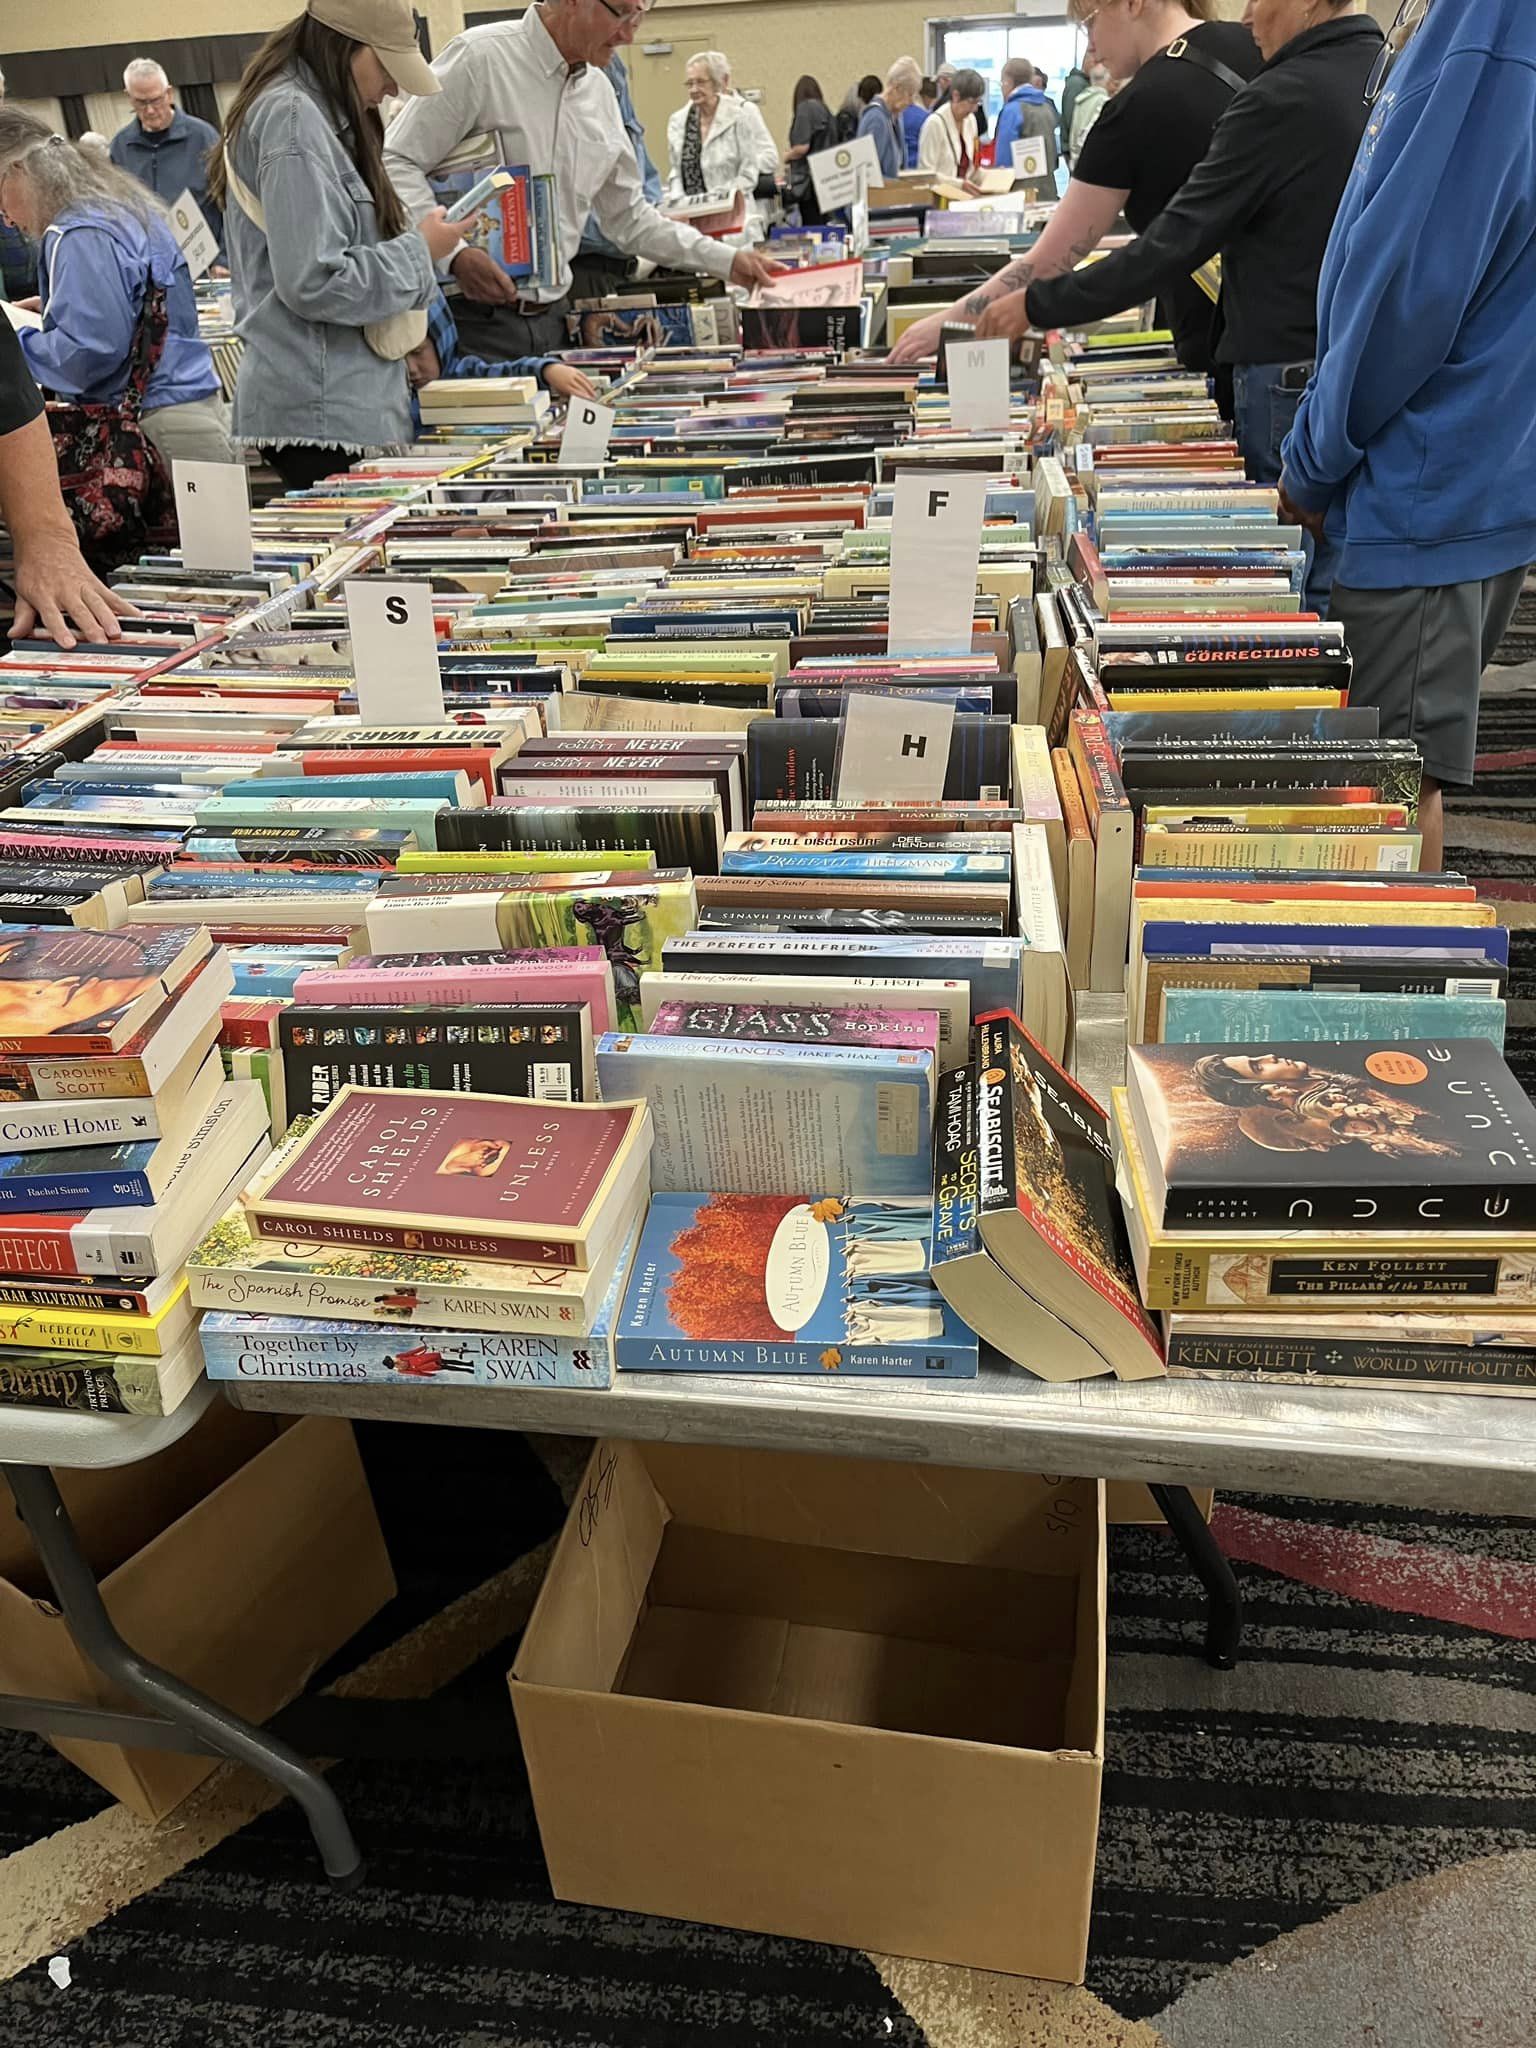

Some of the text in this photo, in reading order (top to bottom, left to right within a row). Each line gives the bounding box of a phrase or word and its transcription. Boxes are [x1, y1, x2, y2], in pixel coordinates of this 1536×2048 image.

[966, 349, 985, 367] M
[582, 408, 596, 425] D
[187, 481, 196, 493] R
[928, 490, 949, 517] F
[385, 595, 409, 625] S
[1184, 647, 1321, 663] CORRECTIONS
[341, 730, 506, 742] DIRTY WARS
[624, 738, 688, 751] NEVER
[901, 734, 928, 759] H
[602, 755, 666, 768] NEVER
[785, 747, 796, 786] window
[770, 837, 882, 847] FULL DISCLOSURE
[892, 841, 972, 849] HENDERSON
[426, 880, 546, 893] THE ILLEGAL
[701, 877, 730, 886] Tales
[750, 879, 766, 888] of
[767, 879, 807, 888] School
[39, 894, 83, 906] JOHN
[720, 912, 770, 920] HAYNES
[671, 940, 880, 952] THE PERFECT GIRLFRIEND
[393, 968, 434, 979] Brain
[497, 963, 575, 973] HAZELWOOD
[883, 979, 924, 988] HOFF
[472, 1002, 517, 1010] ANTHONY
[686, 1005, 926, 1039] GLASS Hopkins
[702, 1043, 786, 1058] CHANCES
[798, 1050, 833, 1059] HAKE
[847, 1053, 882, 1061] HAKE
[981, 1023, 990, 1069] HILLENBRAND
[994, 1031, 1003, 1055] LAURA
[37, 1065, 118, 1081] CAROLINE
[403, 1063, 415, 1077] the
[56, 1081, 106, 1095] SCOTT
[311, 1064, 330, 1106] RIDER
[945, 1084, 963, 1152] TAMI HOAG
[2, 1118, 122, 1141] COME HOME
[985, 1085, 1004, 1182] SEABISCUIT
[347, 1117, 410, 1185] CAROL
[362, 1105, 439, 1199] SHIELDS
[499, 1121, 561, 1203] UNLESS
[950, 1172, 957, 1182] TO
[27, 1185, 91, 1198] Rachel Simon
[958, 1150, 978, 1231] SECRETS
[938, 1173, 958, 1241] THE GRAVE
[1197, 1199, 1250, 1207] FRANK
[262, 1219, 500, 1253] CAROL SHIELDS UNLESS
[1031, 1209, 1074, 1265] LAURA
[780, 1217, 810, 1313] AUTUMN BLUE
[1174, 1252, 1183, 1271] TIMES
[1321, 1260, 1448, 1272] KEN FOLLETT
[1173, 1272, 1181, 1289] YORK
[1182, 1259, 1192, 1300] BESTSELLING
[1191, 1266, 1200, 1293] AUTHOR
[1296, 1281, 1469, 1293] THE PILLARS of the EARTH
[33, 1291, 105, 1309] SILVERMAN
[199, 1273, 371, 1309] The Spanish Promise
[629, 1262, 657, 1328] Karen Harter
[443, 1298, 550, 1319] KAREN SWAN
[39, 1325, 97, 1338] REBECCA
[50, 1337, 91, 1348] SERLE
[236, 1334, 359, 1358] Together by
[479, 1337, 559, 1358] KAREN
[649, 1343, 913, 1367] AUTUMN BLUE Karen Harter
[1177, 1346, 1317, 1368] KEN FOLLETT
[237, 1354, 369, 1379] Christmas
[486, 1359, 557, 1381] SWAN
[1352, 1355, 1418, 1374] WORLD
[1423, 1359, 1512, 1378] WITHOUT
[98, 1375, 110, 1410] PRINCE
